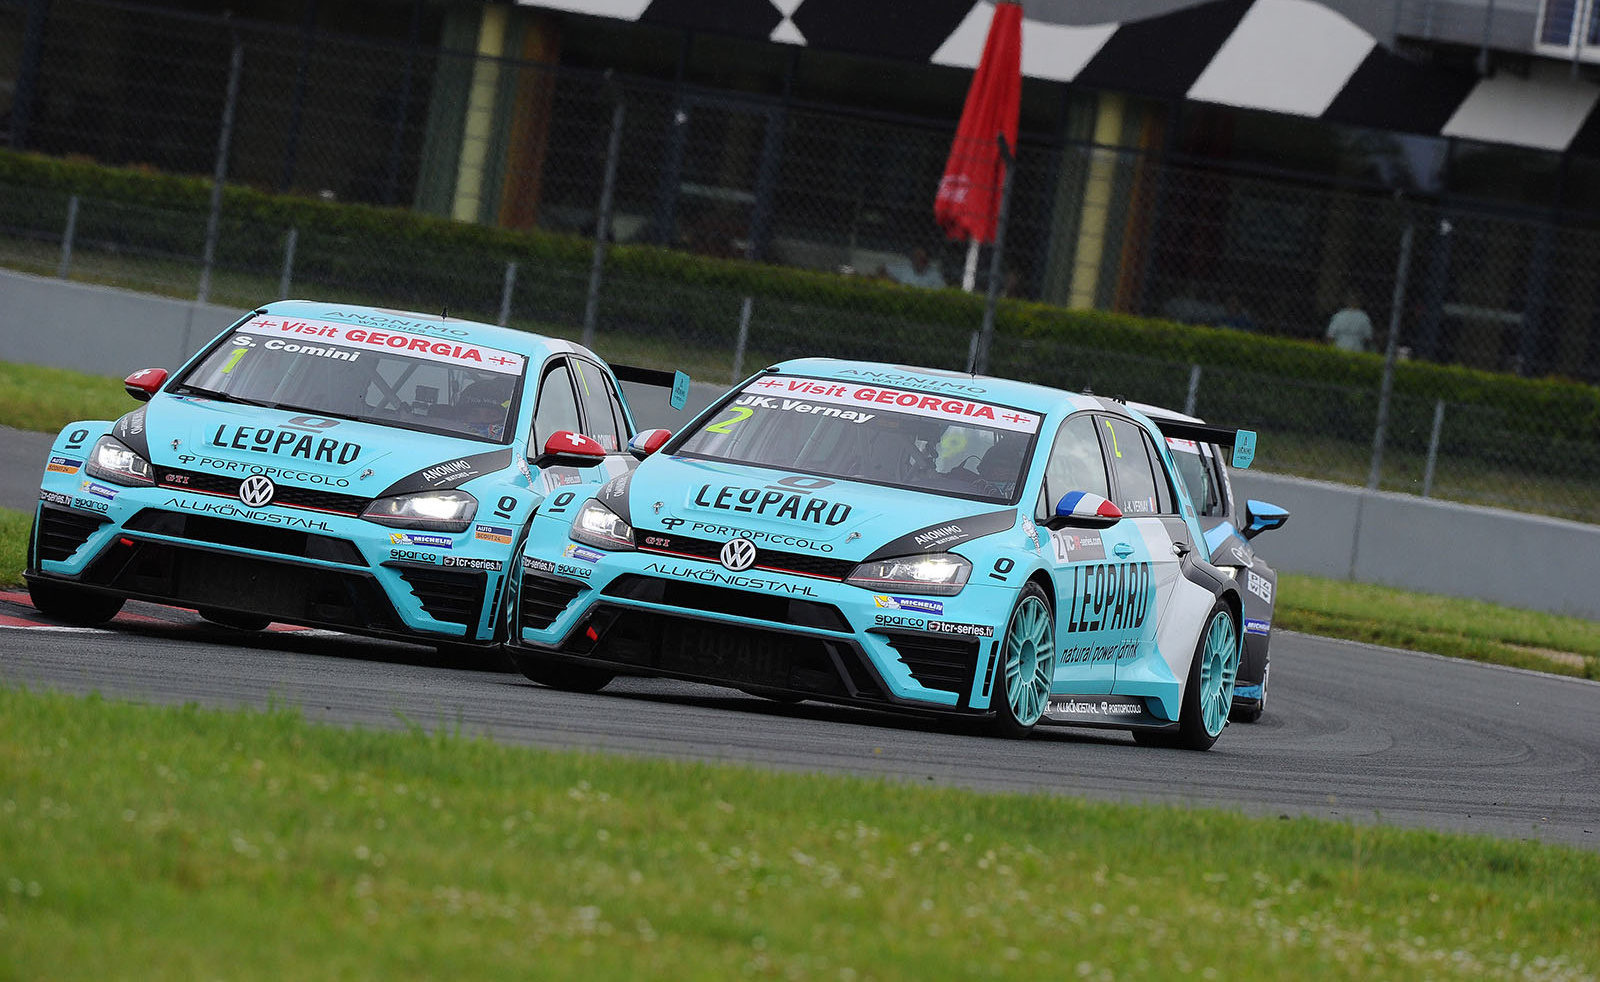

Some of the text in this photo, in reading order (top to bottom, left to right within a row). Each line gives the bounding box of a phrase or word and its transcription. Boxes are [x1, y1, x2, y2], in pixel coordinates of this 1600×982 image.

[325, 311, 469, 336] ANONIMO
[358, 320, 427, 333] WATCHES
[231, 336, 361, 362] S. Comini
[281, 320, 483, 363] Visit GEORGIA
[221, 348, 248, 374] 1
[837, 369, 986, 393] ANONIMO
[872, 378, 941, 391] WATCHES
[787, 379, 995, 420] Visit GEORGIA
[704, 407, 754, 435] 2
[212, 423, 363, 466] LEOPARD
[1105, 420, 1122, 458] 2
[165, 473, 190, 485] GTI
[200, 458, 350, 487] PORTOPICCOLO
[422, 460, 471, 482] ANONIMO
[75, 498, 109, 513] sparco
[164, 498, 334, 532] ALUKÖNIGSTAHL
[694, 483, 852, 526] LEOPARD
[413, 536, 452, 545] MICHELIN
[645, 536, 671, 547] GTI
[691, 522, 834, 553] PORTOPICCOLO
[914, 525, 962, 545] ANONIMO
[390, 549, 436, 563] sparco
[456, 558, 502, 570] tcr-series.tv
[557, 564, 592, 579] sparco
[644, 562, 818, 597] ALUKÖNIGSTAHL
[900, 599, 943, 611] MICHELIN
[1068, 562, 1149, 633] LEOPARD
[875, 614, 924, 629] sparco
[941, 621, 994, 637] tcr-series.tv
[1060, 638, 1140, 669] natural power drink
